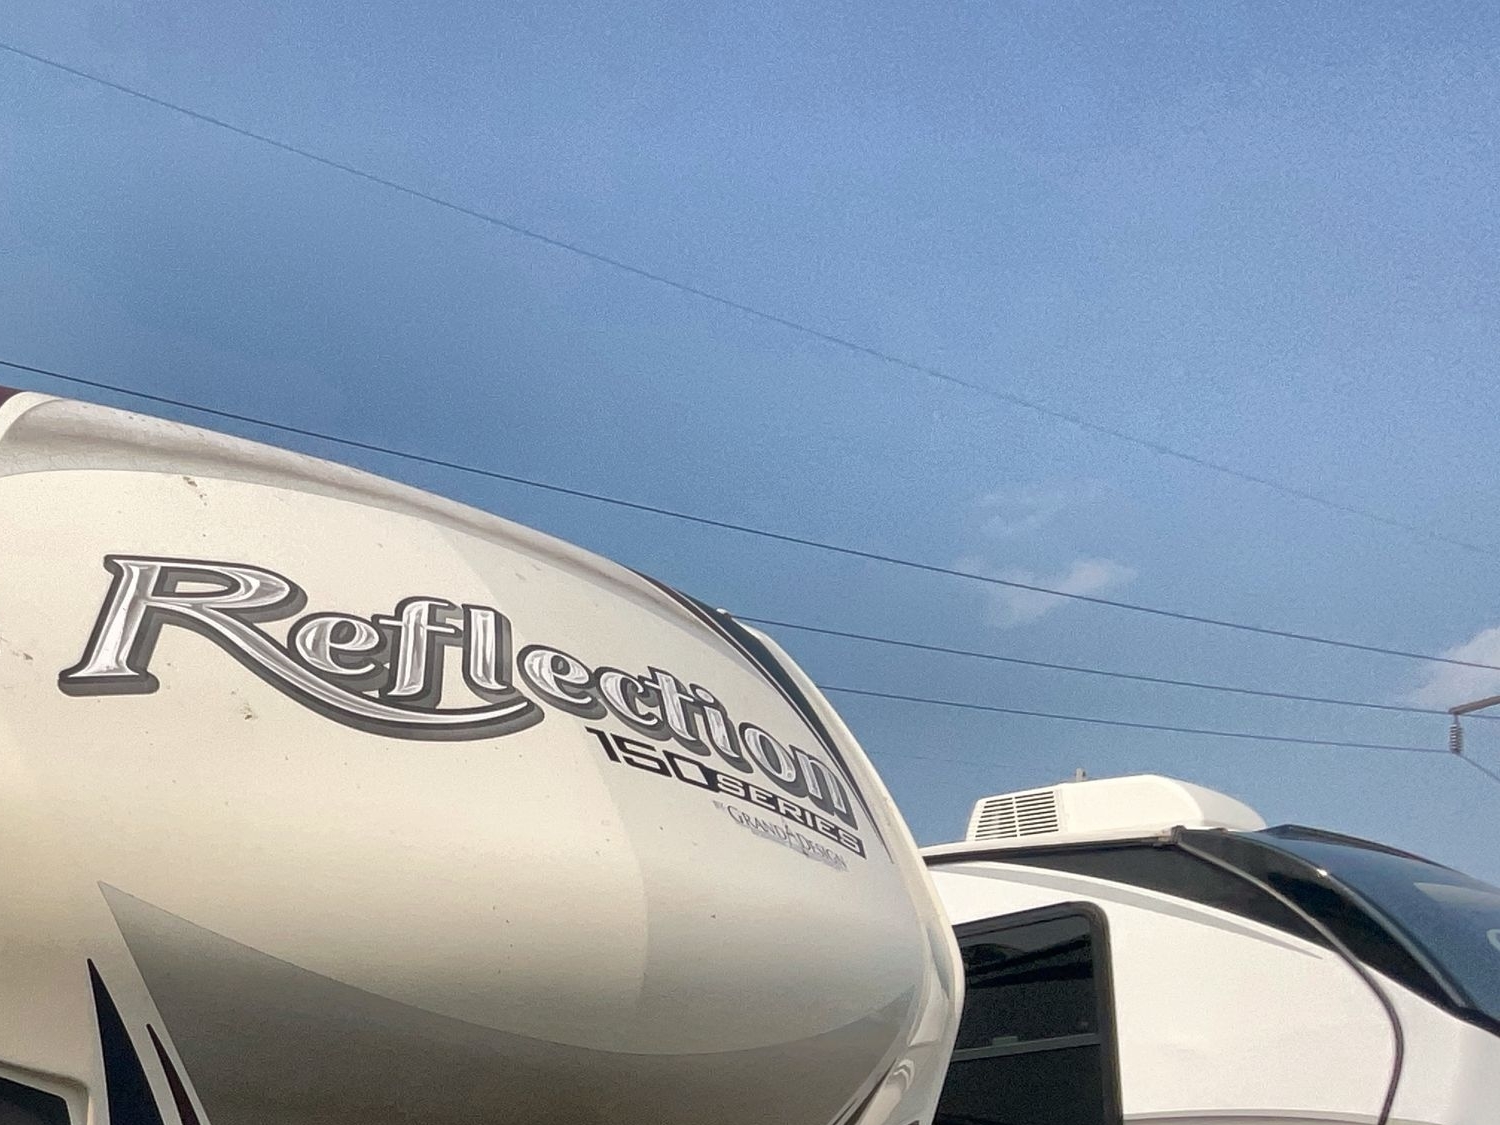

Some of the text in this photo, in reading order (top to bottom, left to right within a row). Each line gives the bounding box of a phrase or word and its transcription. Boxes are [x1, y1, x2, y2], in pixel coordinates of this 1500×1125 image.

[58, 554, 858, 830] Reflection
[585, 726, 864, 857] 150 SERIES
[727, 805, 787, 841] GRAND
